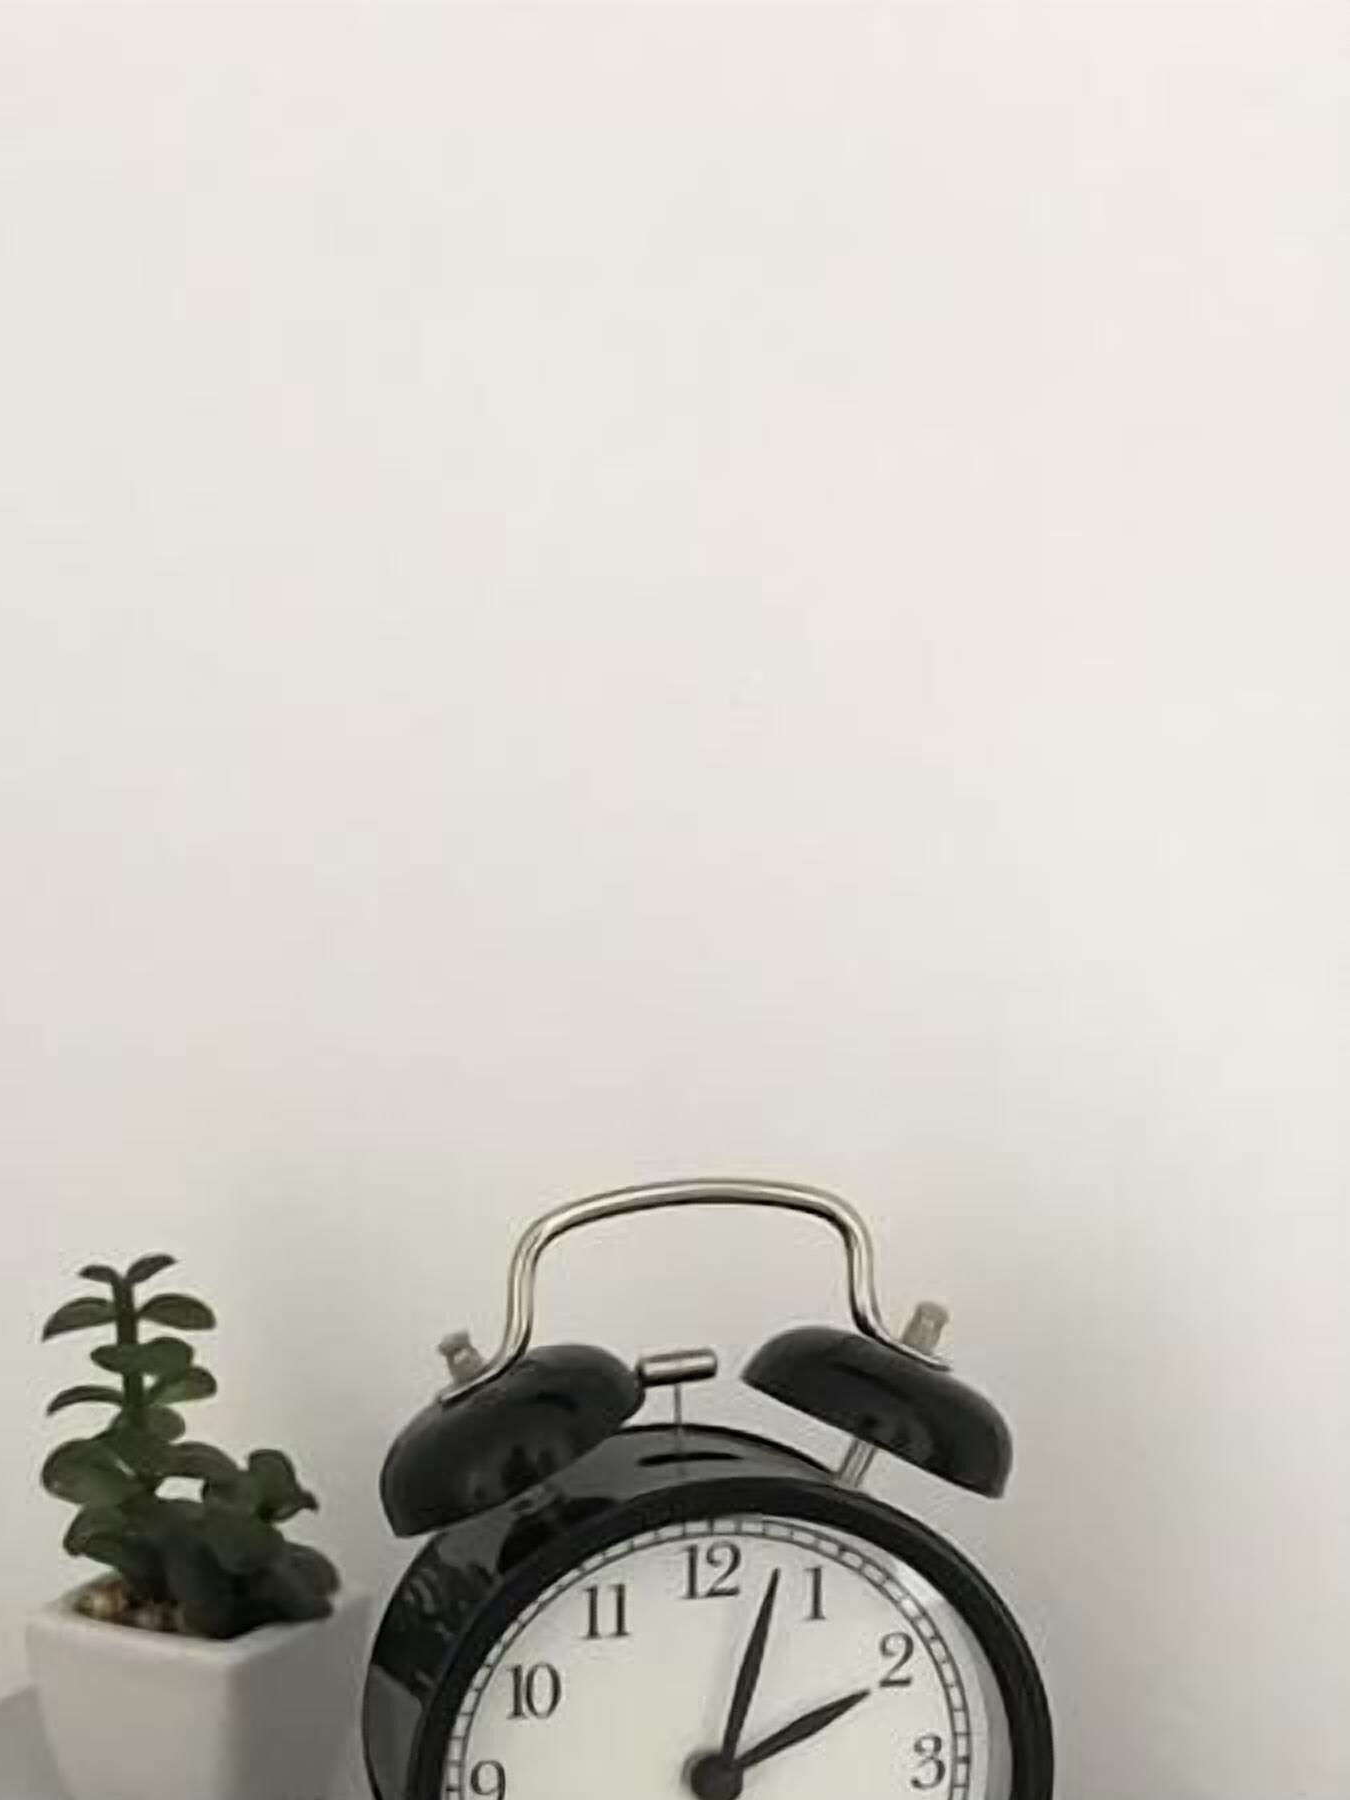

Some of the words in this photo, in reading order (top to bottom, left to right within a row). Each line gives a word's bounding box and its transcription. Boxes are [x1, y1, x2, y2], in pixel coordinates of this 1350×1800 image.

[680, 1541, 742, 1600] 12
[802, 1566, 828, 1621] 1
[580, 1584, 631, 1640] 11
[879, 1632, 914, 1688] 2
[505, 1662, 563, 1721] 10
[910, 1735, 947, 1790] 3
